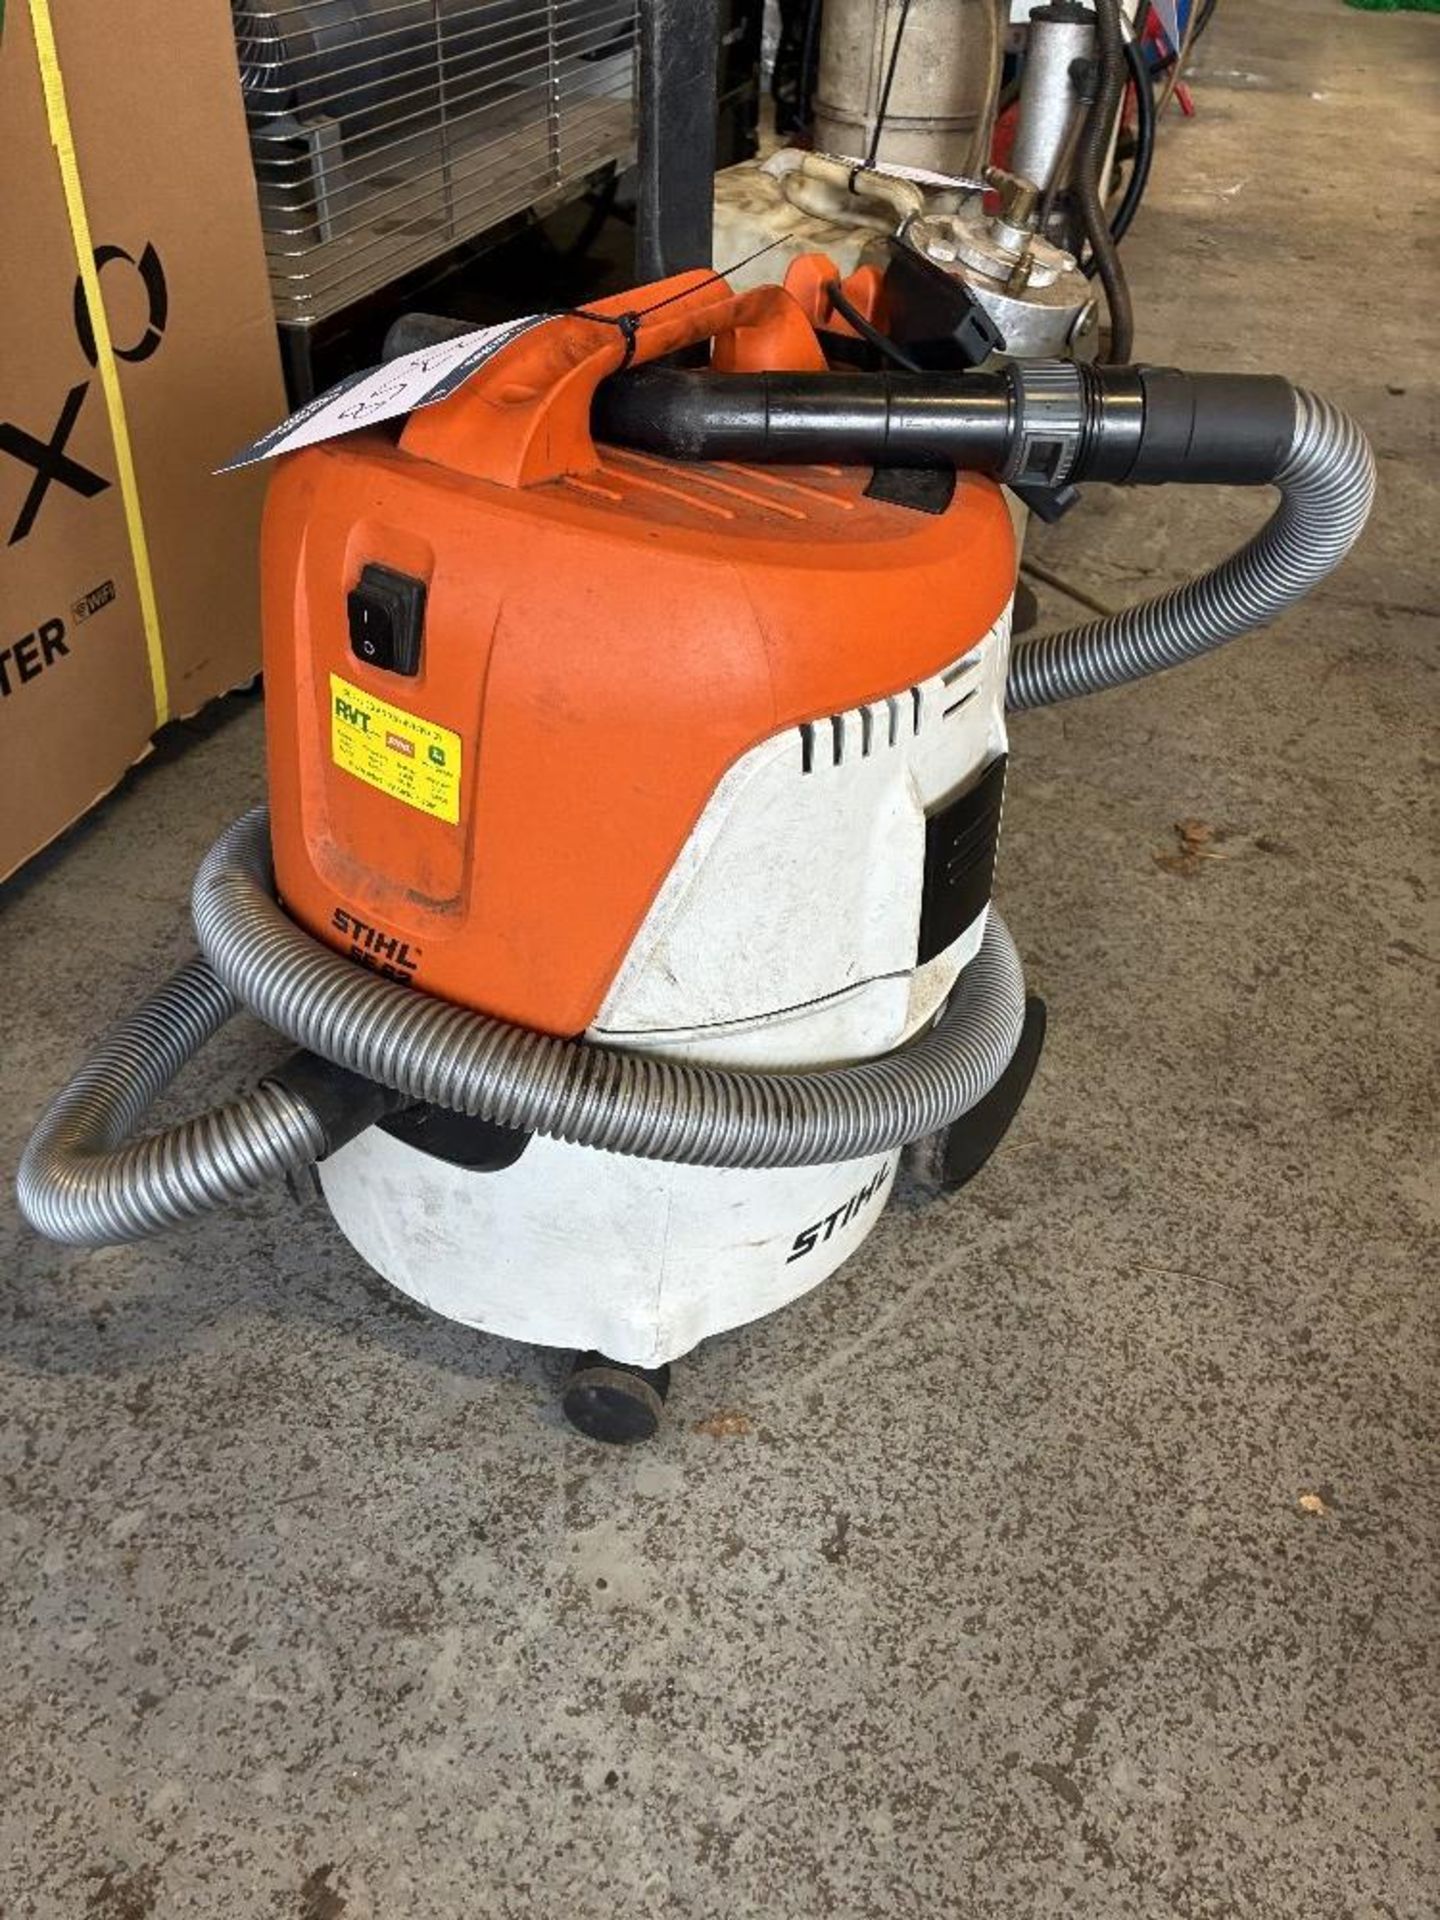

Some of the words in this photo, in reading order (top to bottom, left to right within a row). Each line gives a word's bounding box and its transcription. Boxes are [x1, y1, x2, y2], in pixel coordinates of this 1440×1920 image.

[335, 696, 372, 734] RVT
[331, 907, 418, 970] STIHL
[785, 1160, 893, 1264] STIHL
